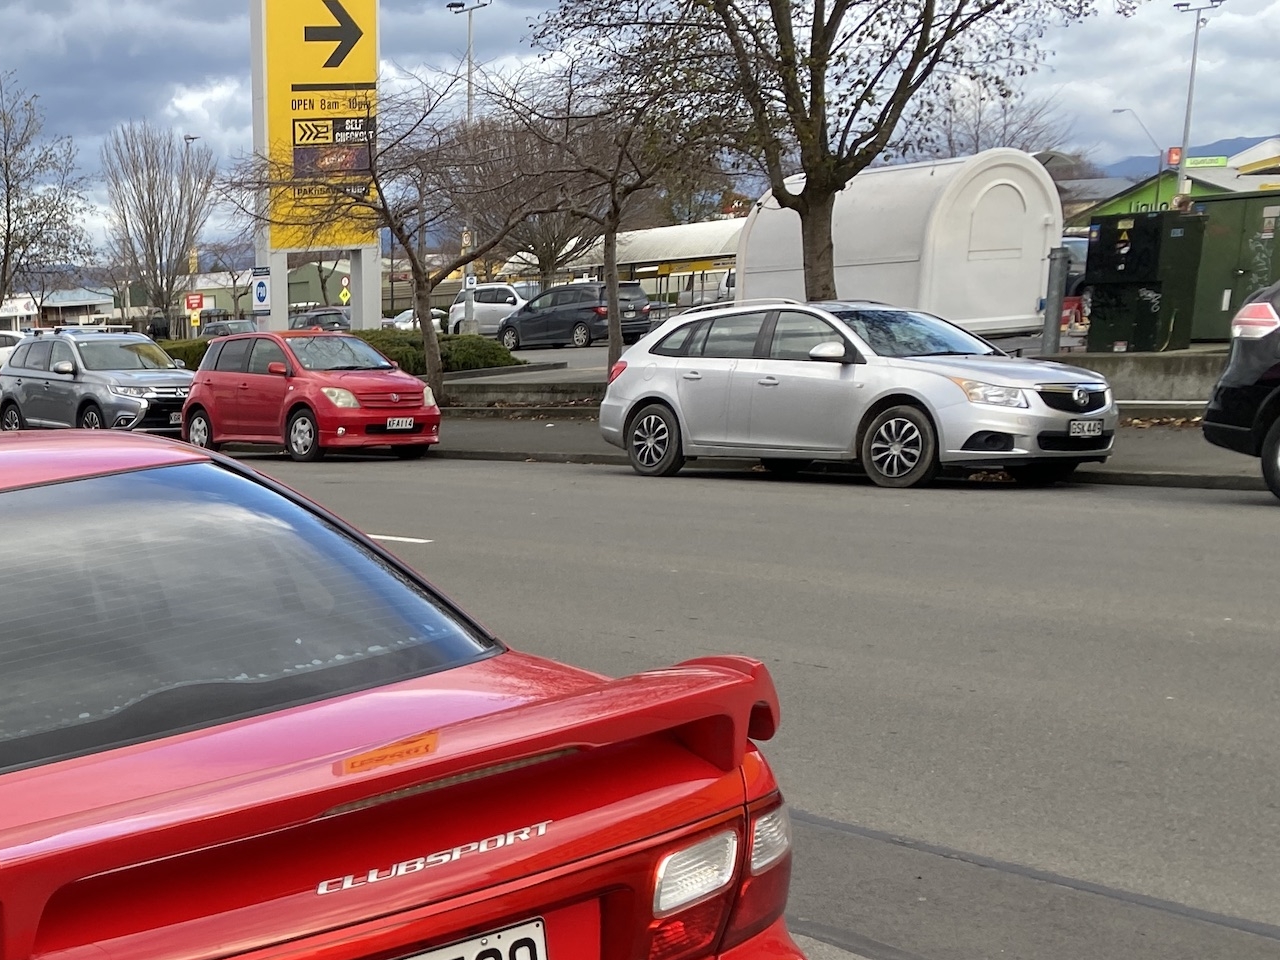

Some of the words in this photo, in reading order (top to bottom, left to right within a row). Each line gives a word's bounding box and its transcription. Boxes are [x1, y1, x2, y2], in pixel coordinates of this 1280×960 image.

[291, 99, 315, 111] OPEN
[320, 98, 340, 110] 8am
[345, 119, 364, 131] SELF
[316, 820, 553, 896] CLUBSPORT
